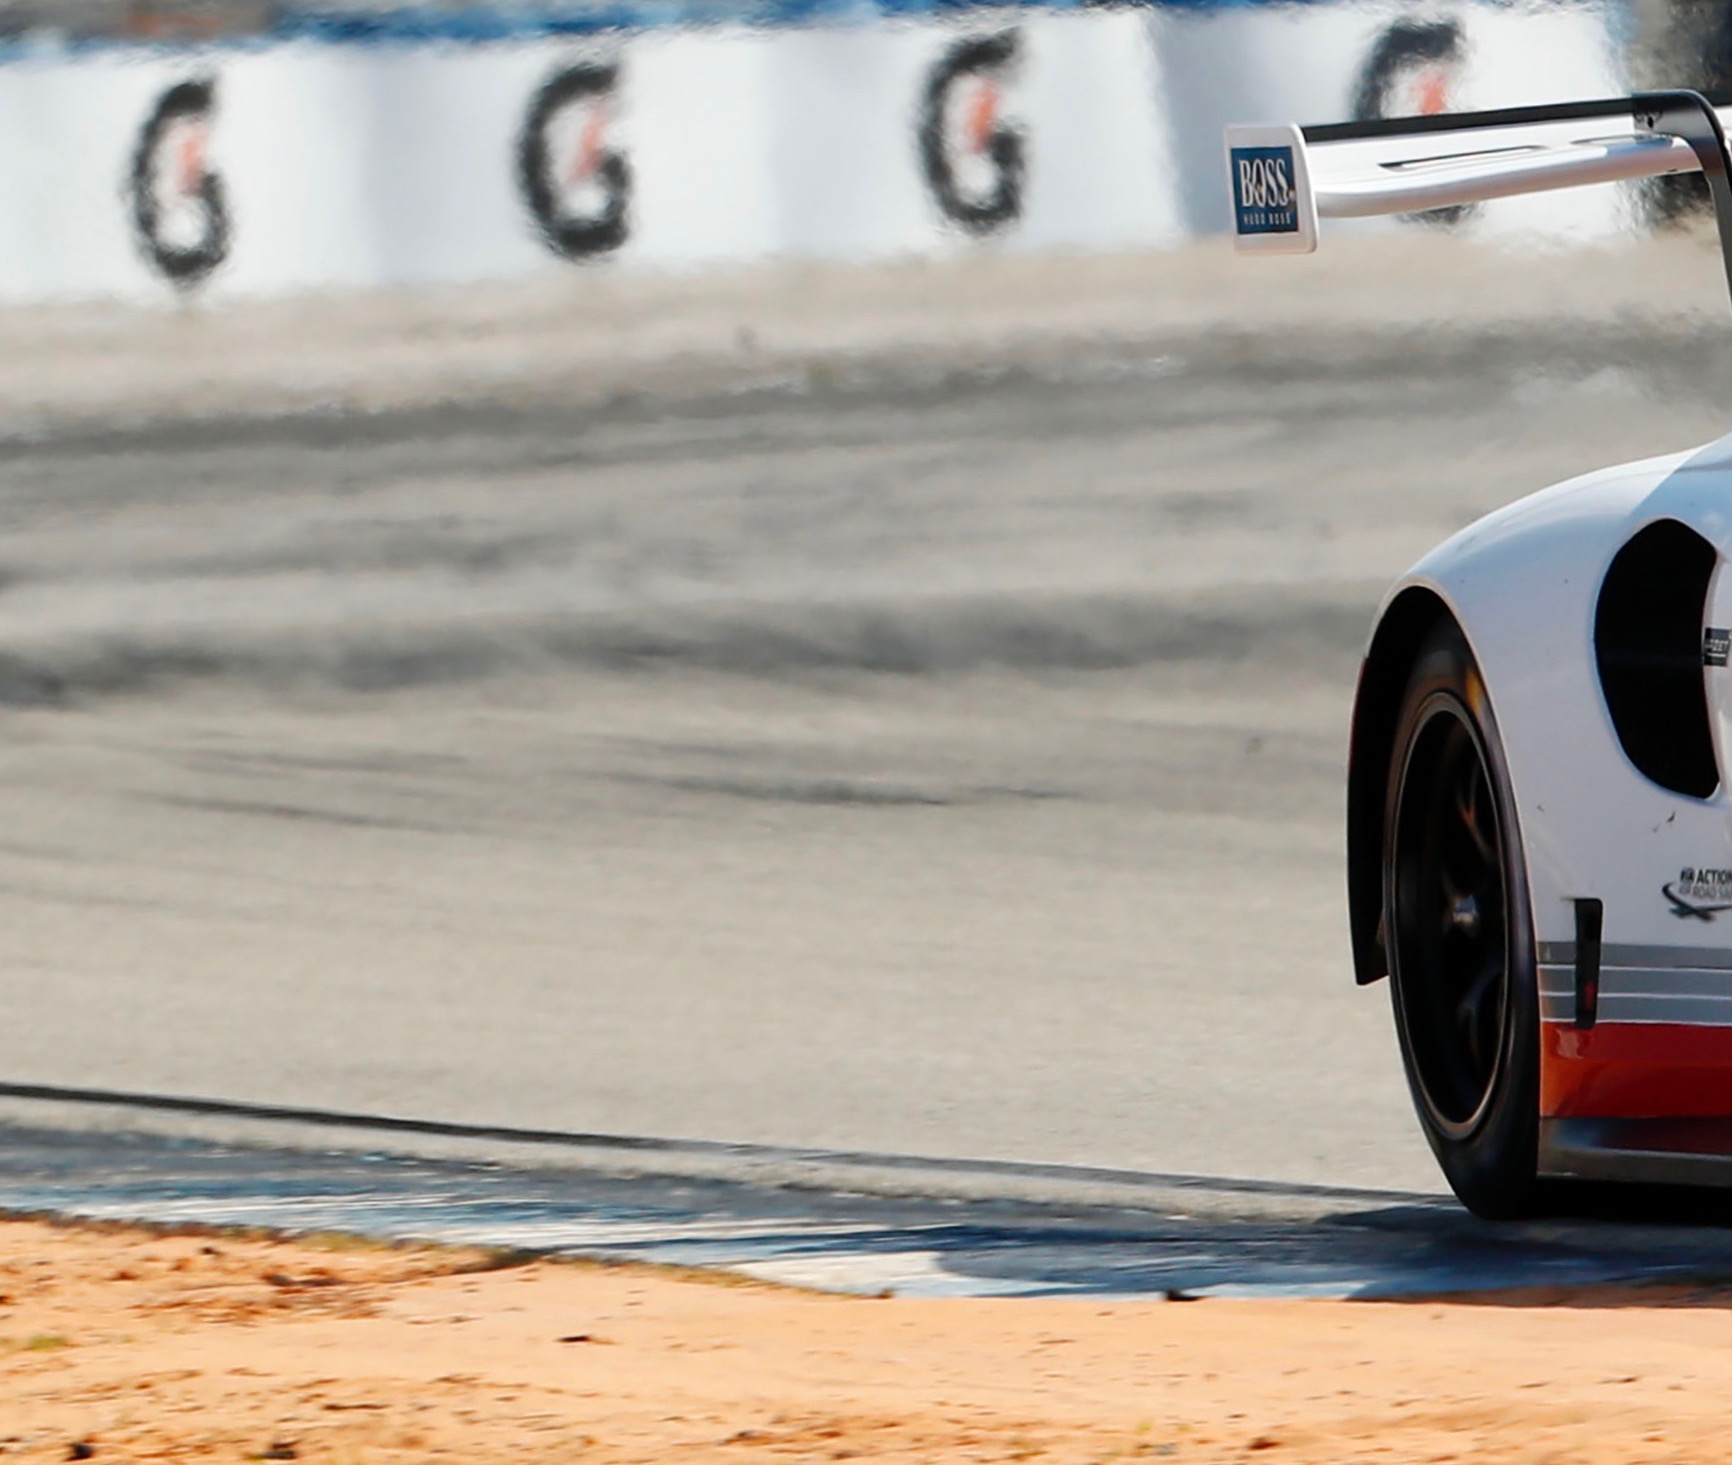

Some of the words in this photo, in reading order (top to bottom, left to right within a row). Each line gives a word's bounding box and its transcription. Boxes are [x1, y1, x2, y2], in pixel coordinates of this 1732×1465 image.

[129, 76, 231, 285] G
[518, 61, 633, 262] G
[1239, 157, 1289, 208] BOSS
